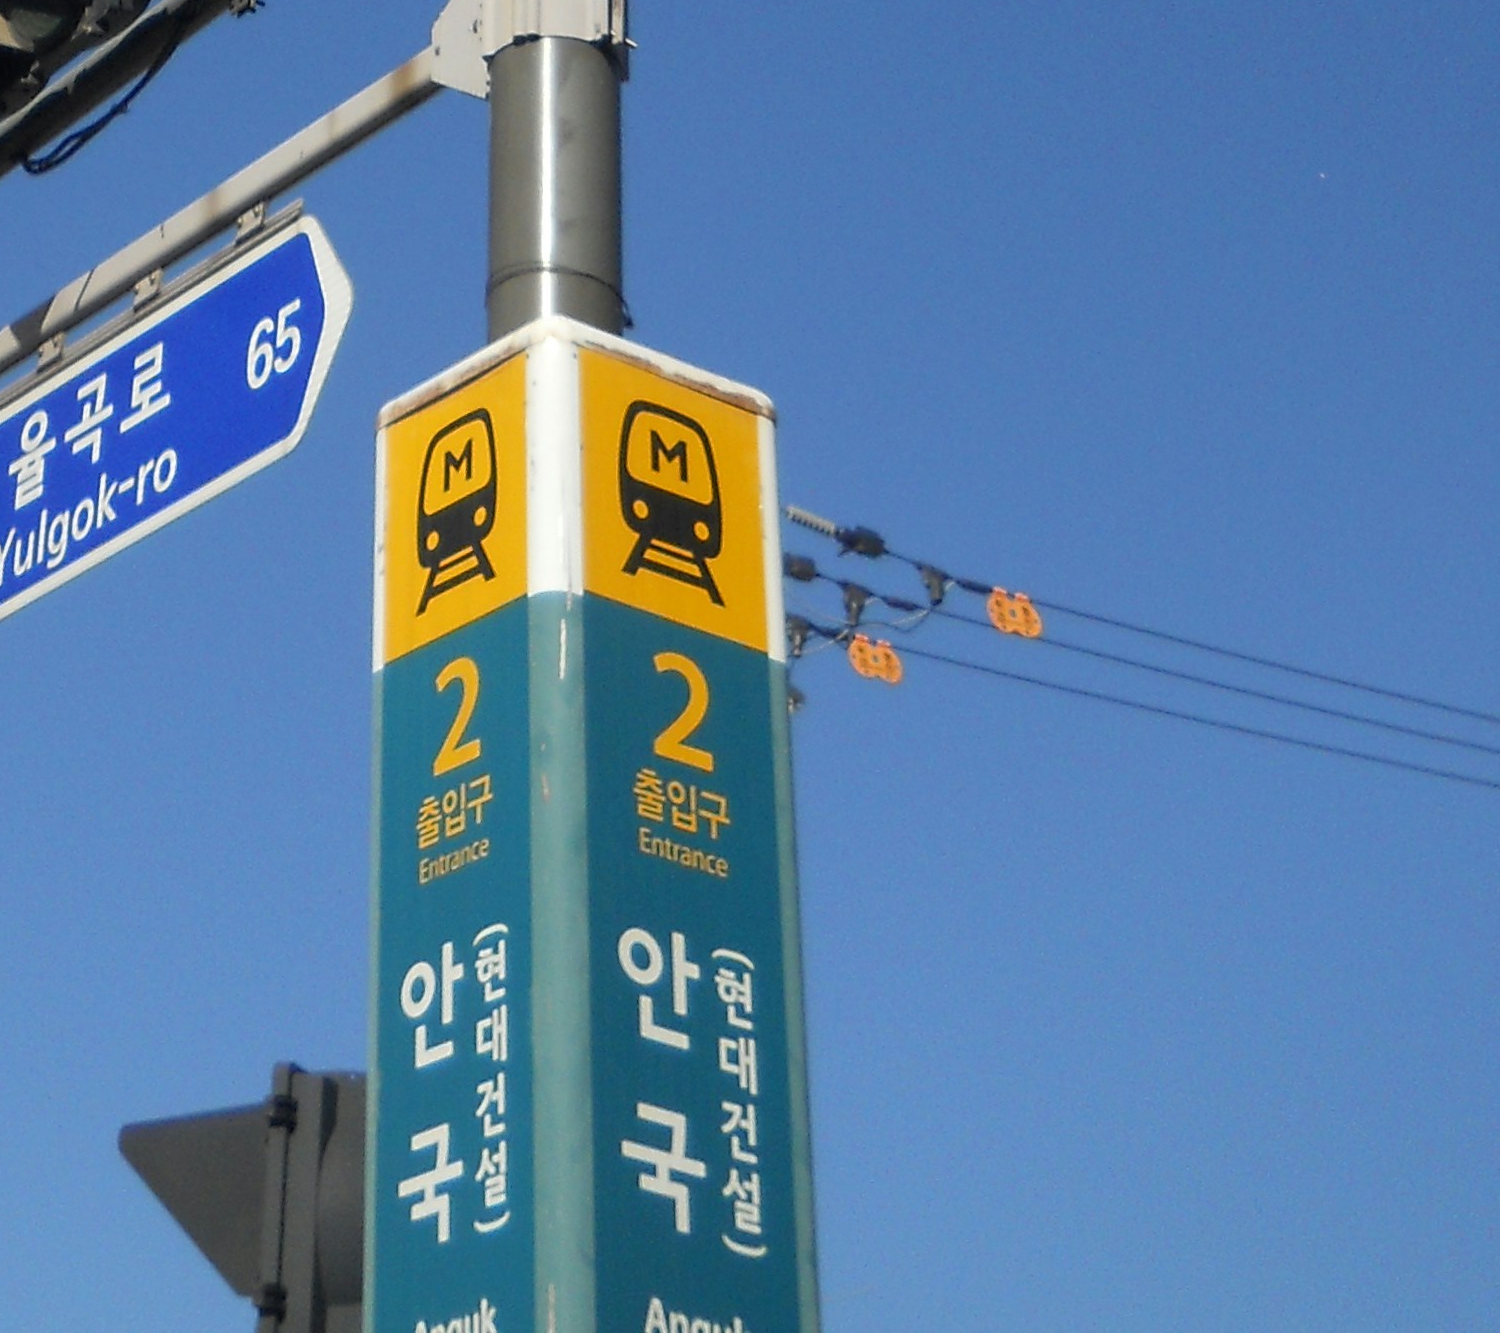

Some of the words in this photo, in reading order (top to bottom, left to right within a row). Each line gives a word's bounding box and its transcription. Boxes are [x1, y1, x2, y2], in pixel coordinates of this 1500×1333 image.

[246, 298, 301, 390] 65
[8, 341, 171, 511] 율곡로
[433, 655, 482, 777] 2
[652, 651, 714, 773] 2
[416, 774, 493, 850] 출입구
[418, 838, 490, 885] Entrance
[633, 768, 731, 840] 출입구
[638, 826, 729, 878] Entrance
[398, 941, 464, 1244] 안국
[472, 922, 510, 1233] (현대건설)
[618, 927, 707, 1234] 안국
[710, 947, 768, 1258] (현대건설)
